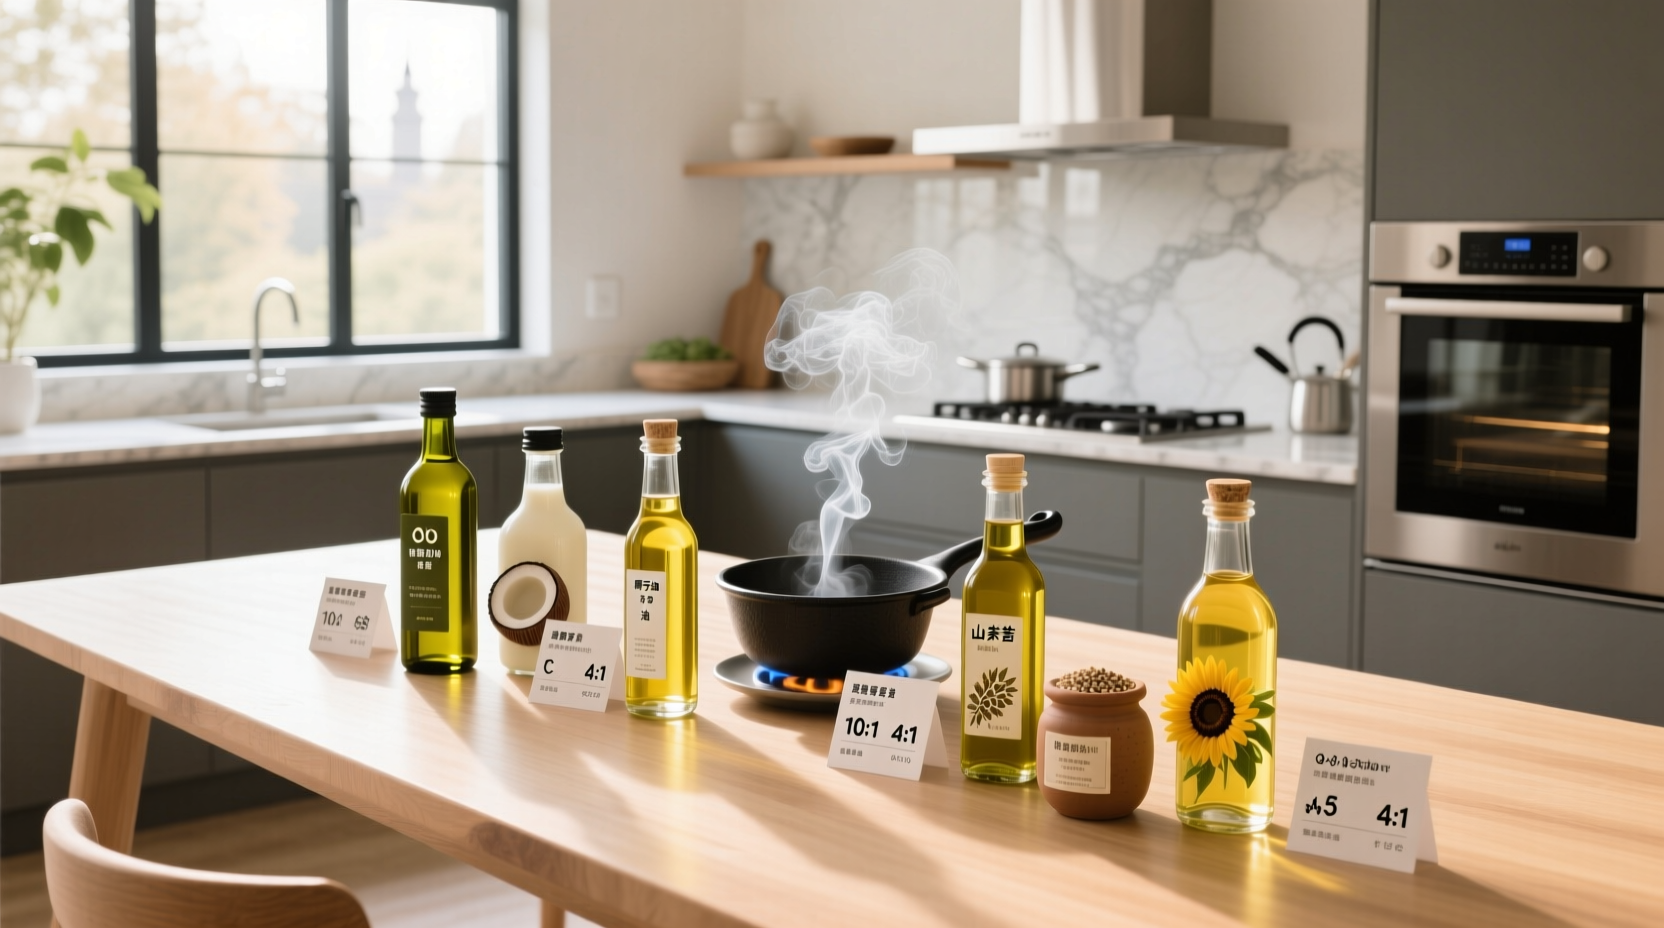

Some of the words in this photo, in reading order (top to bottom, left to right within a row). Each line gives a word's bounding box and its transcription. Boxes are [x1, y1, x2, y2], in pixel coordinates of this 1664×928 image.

[543, 659, 554, 675] C
[584, 663, 606, 681] 4:1
[845, 717, 879, 738] 10:1
[891, 724, 918, 744] 4:1
[1376, 804, 1409, 829] 4:1
